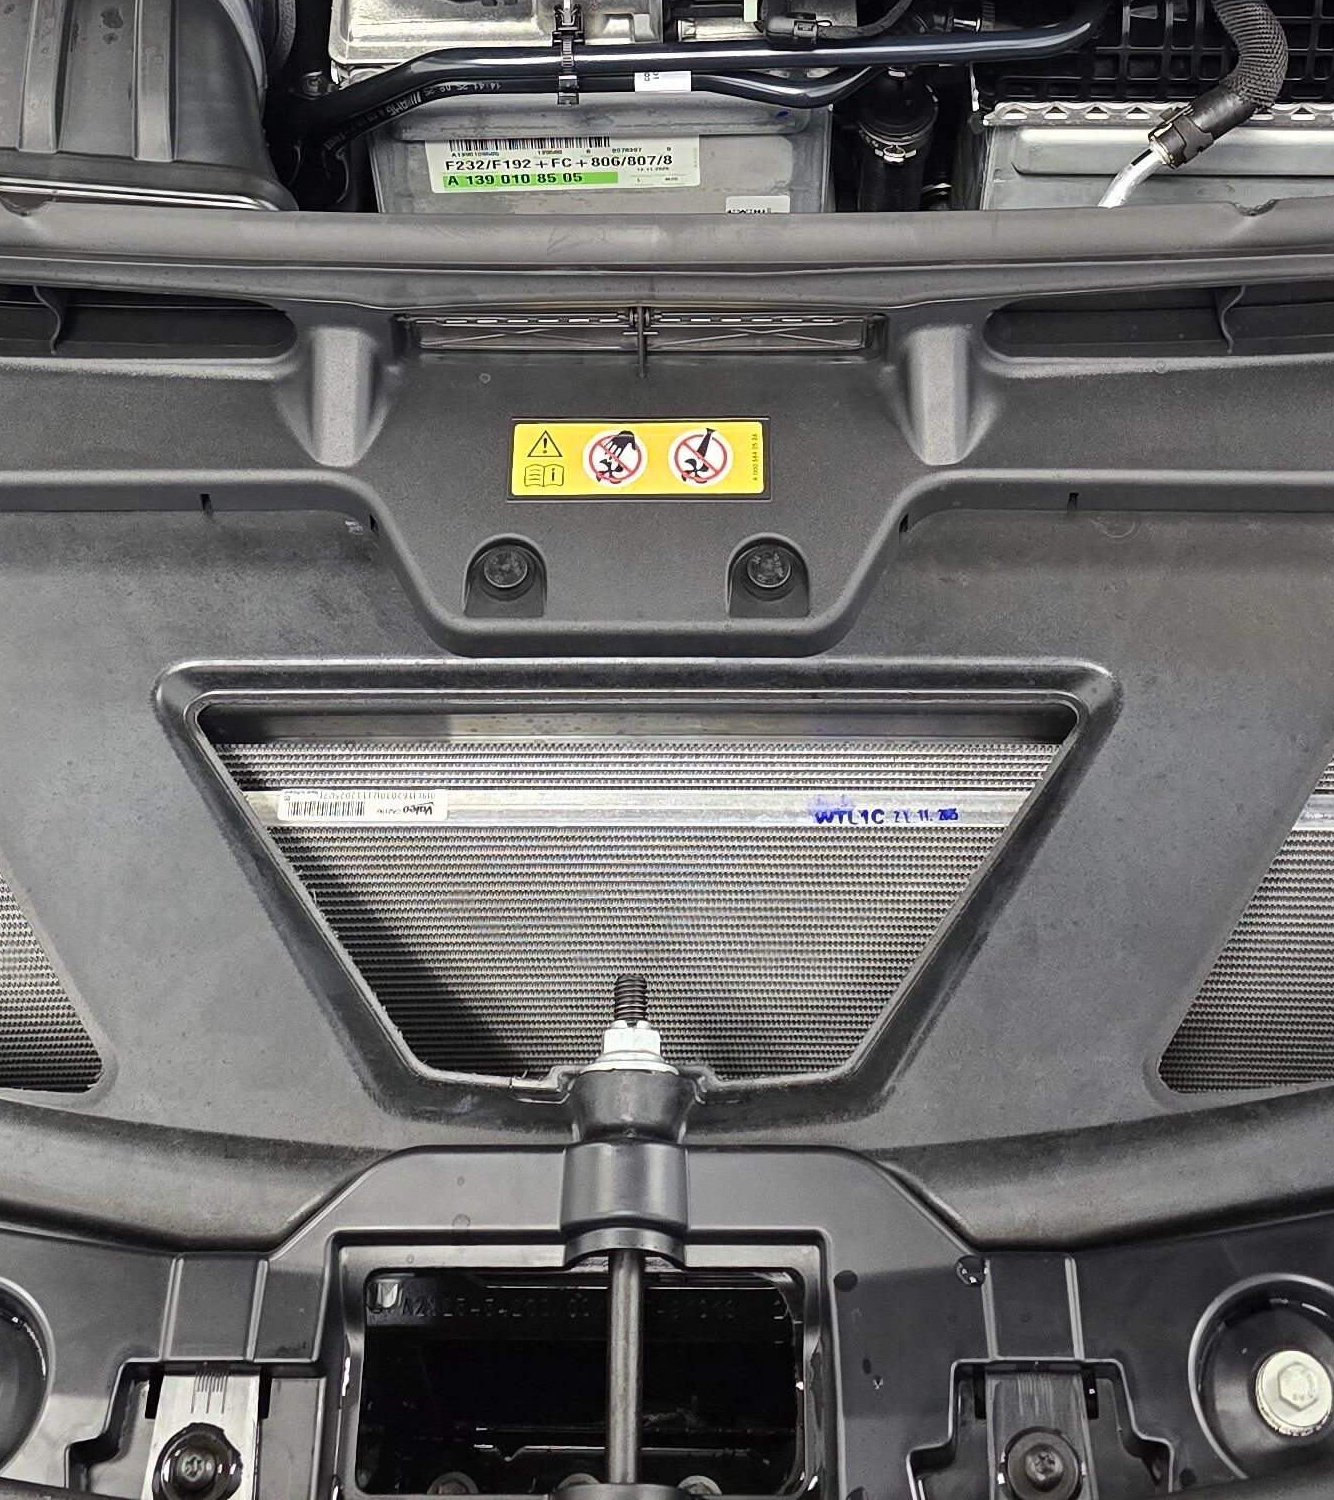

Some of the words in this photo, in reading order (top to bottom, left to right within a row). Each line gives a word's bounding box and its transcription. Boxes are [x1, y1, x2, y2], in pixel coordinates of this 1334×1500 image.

[445, 159, 532, 172] F232/F192
[535, 159, 549, 169] +
[551, 157, 572, 169] FC
[575, 158, 589, 169] +
[591, 155, 673, 168] 806/807/8
[447, 174, 459, 186] A
[466, 174, 495, 185] 139
[501, 174, 531, 185] 010
[537, 173, 557, 184] 85
[562, 173, 583, 183] 05
[402, 804, 433, 815] Valeo
[814, 808, 886, 825] WTL1C
